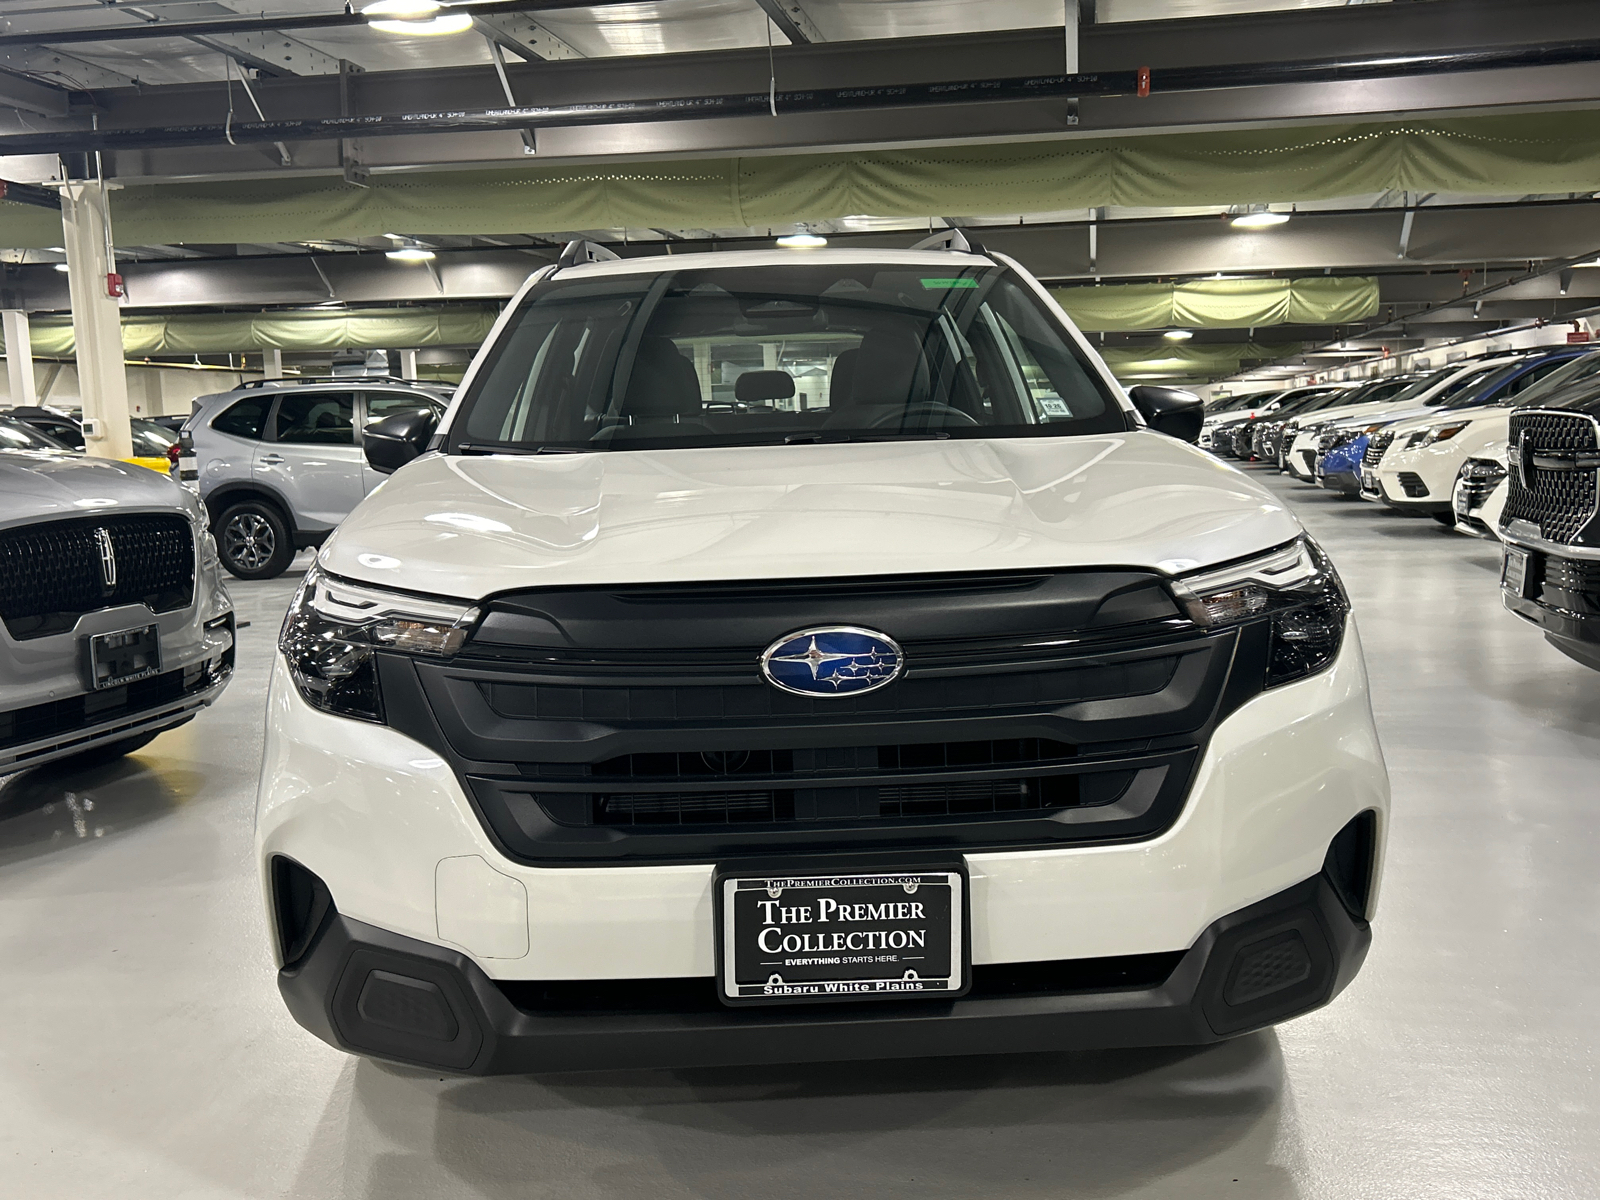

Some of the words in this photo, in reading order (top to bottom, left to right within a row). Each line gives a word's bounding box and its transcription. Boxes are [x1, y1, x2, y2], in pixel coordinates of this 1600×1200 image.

[758, 900, 812, 925] THE
[817, 898, 926, 923] PREMIER
[758, 927, 926, 953] COLLECTION
[785, 957, 840, 966] EVERYTHING
[842, 956, 873, 964] STARTS
[875, 955, 899, 963] HERE.
[764, 984, 818, 995] Subaru
[824, 982, 869, 992] White
[876, 981, 923, 991] Plains
